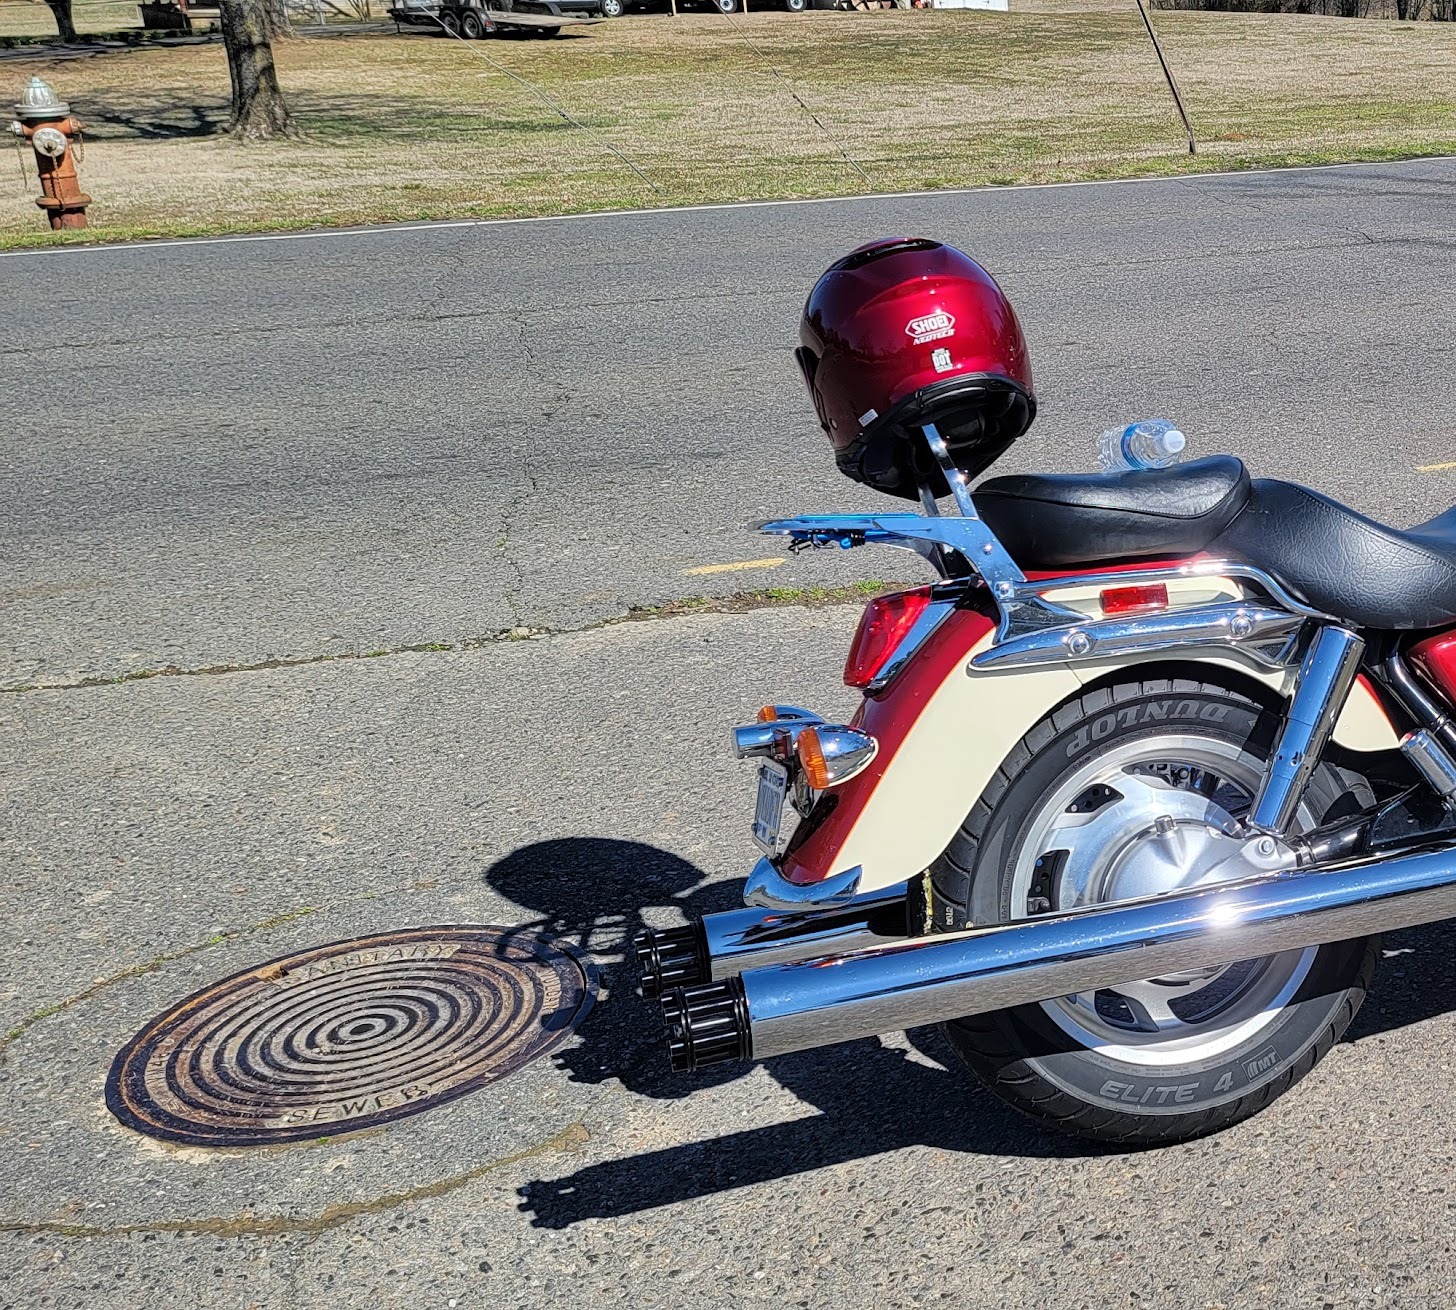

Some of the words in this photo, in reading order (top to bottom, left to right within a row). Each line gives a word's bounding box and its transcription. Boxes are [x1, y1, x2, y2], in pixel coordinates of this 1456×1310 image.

[911, 314, 949, 335] SHOEI
[1066, 700, 1233, 758] DUNLOP
[279, 945, 452, 987] SANITARY
[287, 1085, 428, 1123] SEWER
[1099, 1080, 1200, 1104] ELITE
[1213, 1071, 1234, 1092] 4
